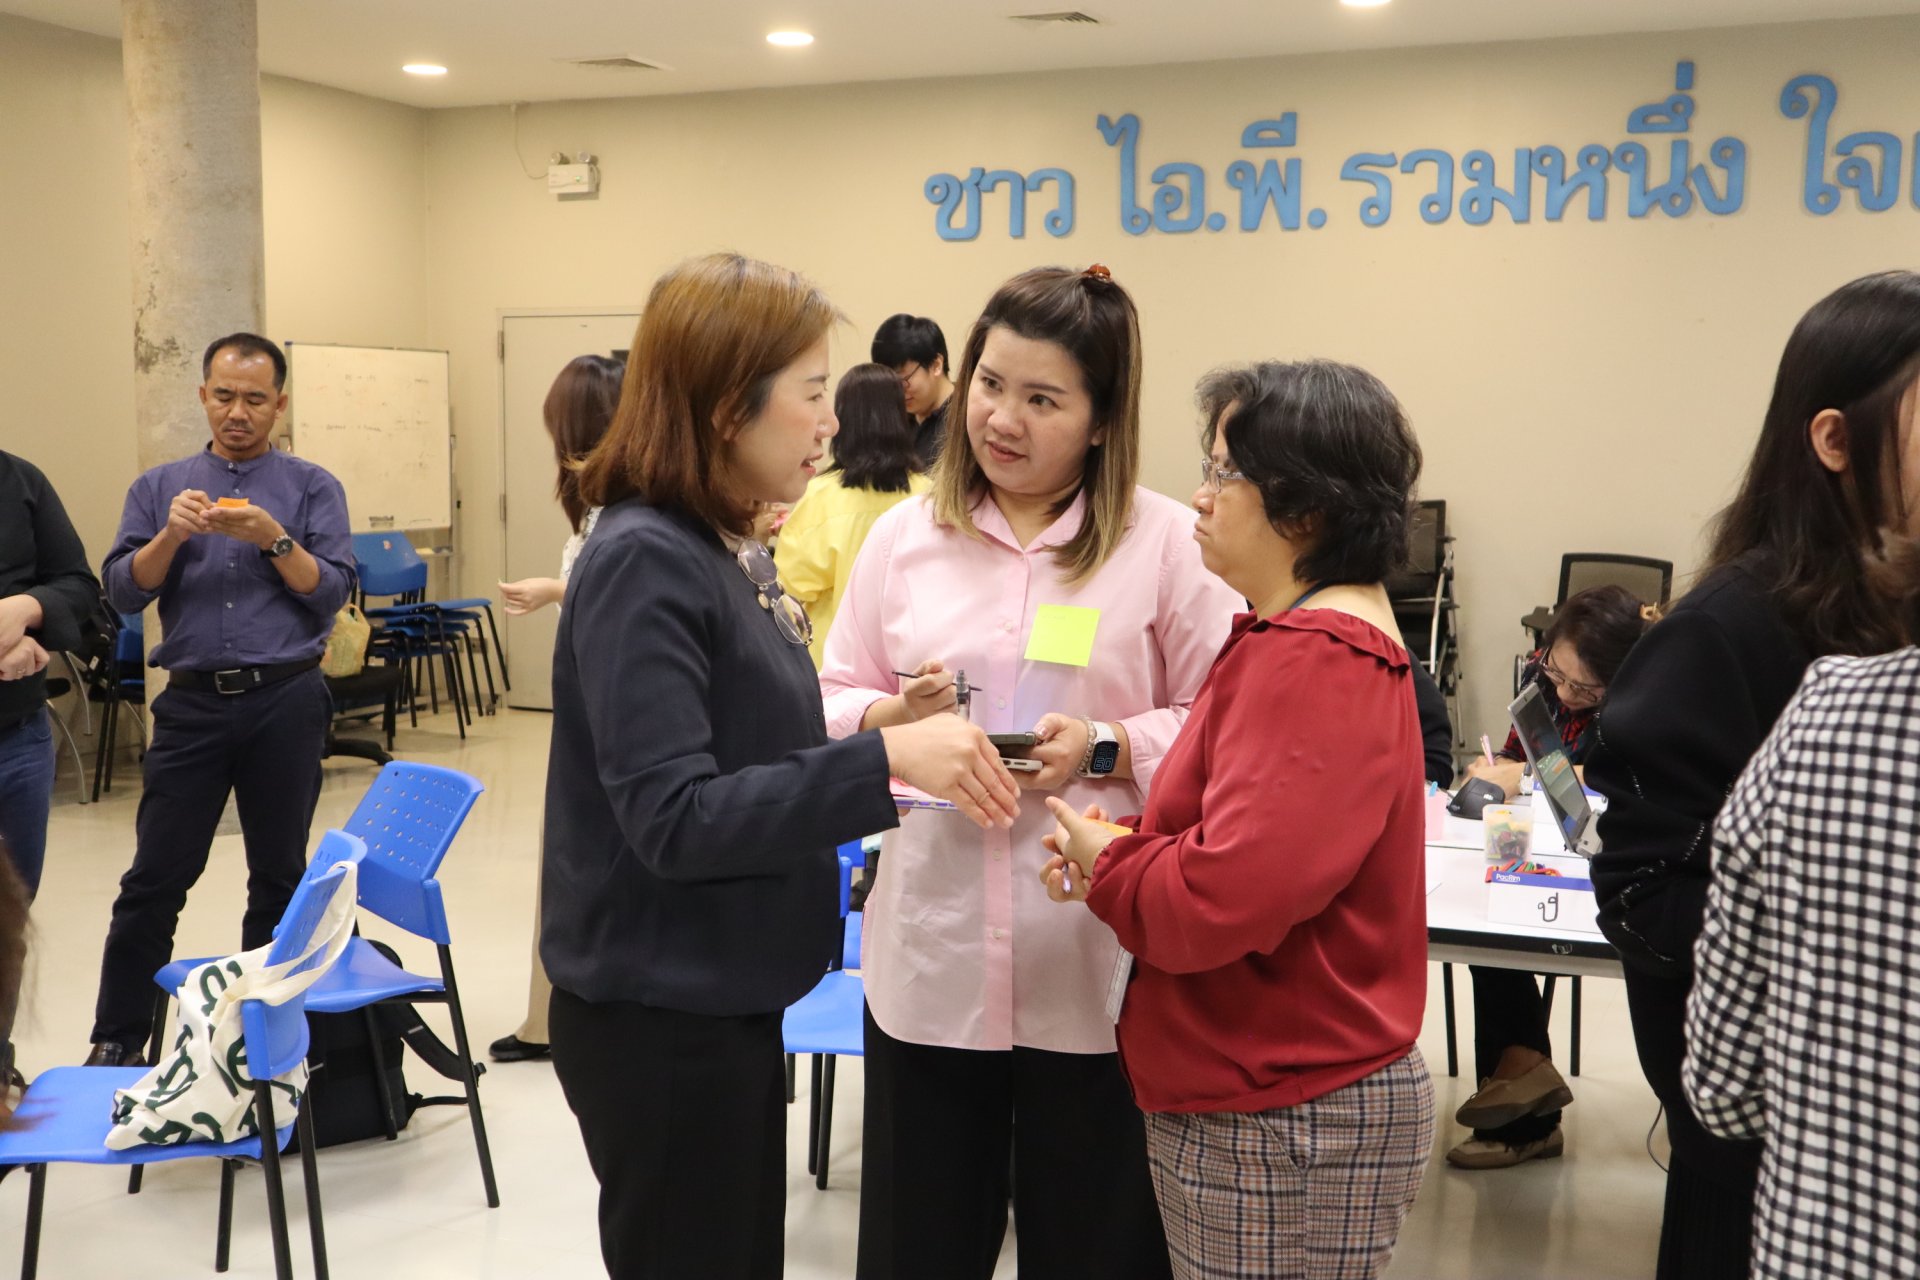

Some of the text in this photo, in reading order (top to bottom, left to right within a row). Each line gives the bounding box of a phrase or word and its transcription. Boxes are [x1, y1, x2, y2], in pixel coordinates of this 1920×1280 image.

[924, 168, 1073, 240] ชาว
[1340, 61, 1746, 226] รวมหนึ่ง
